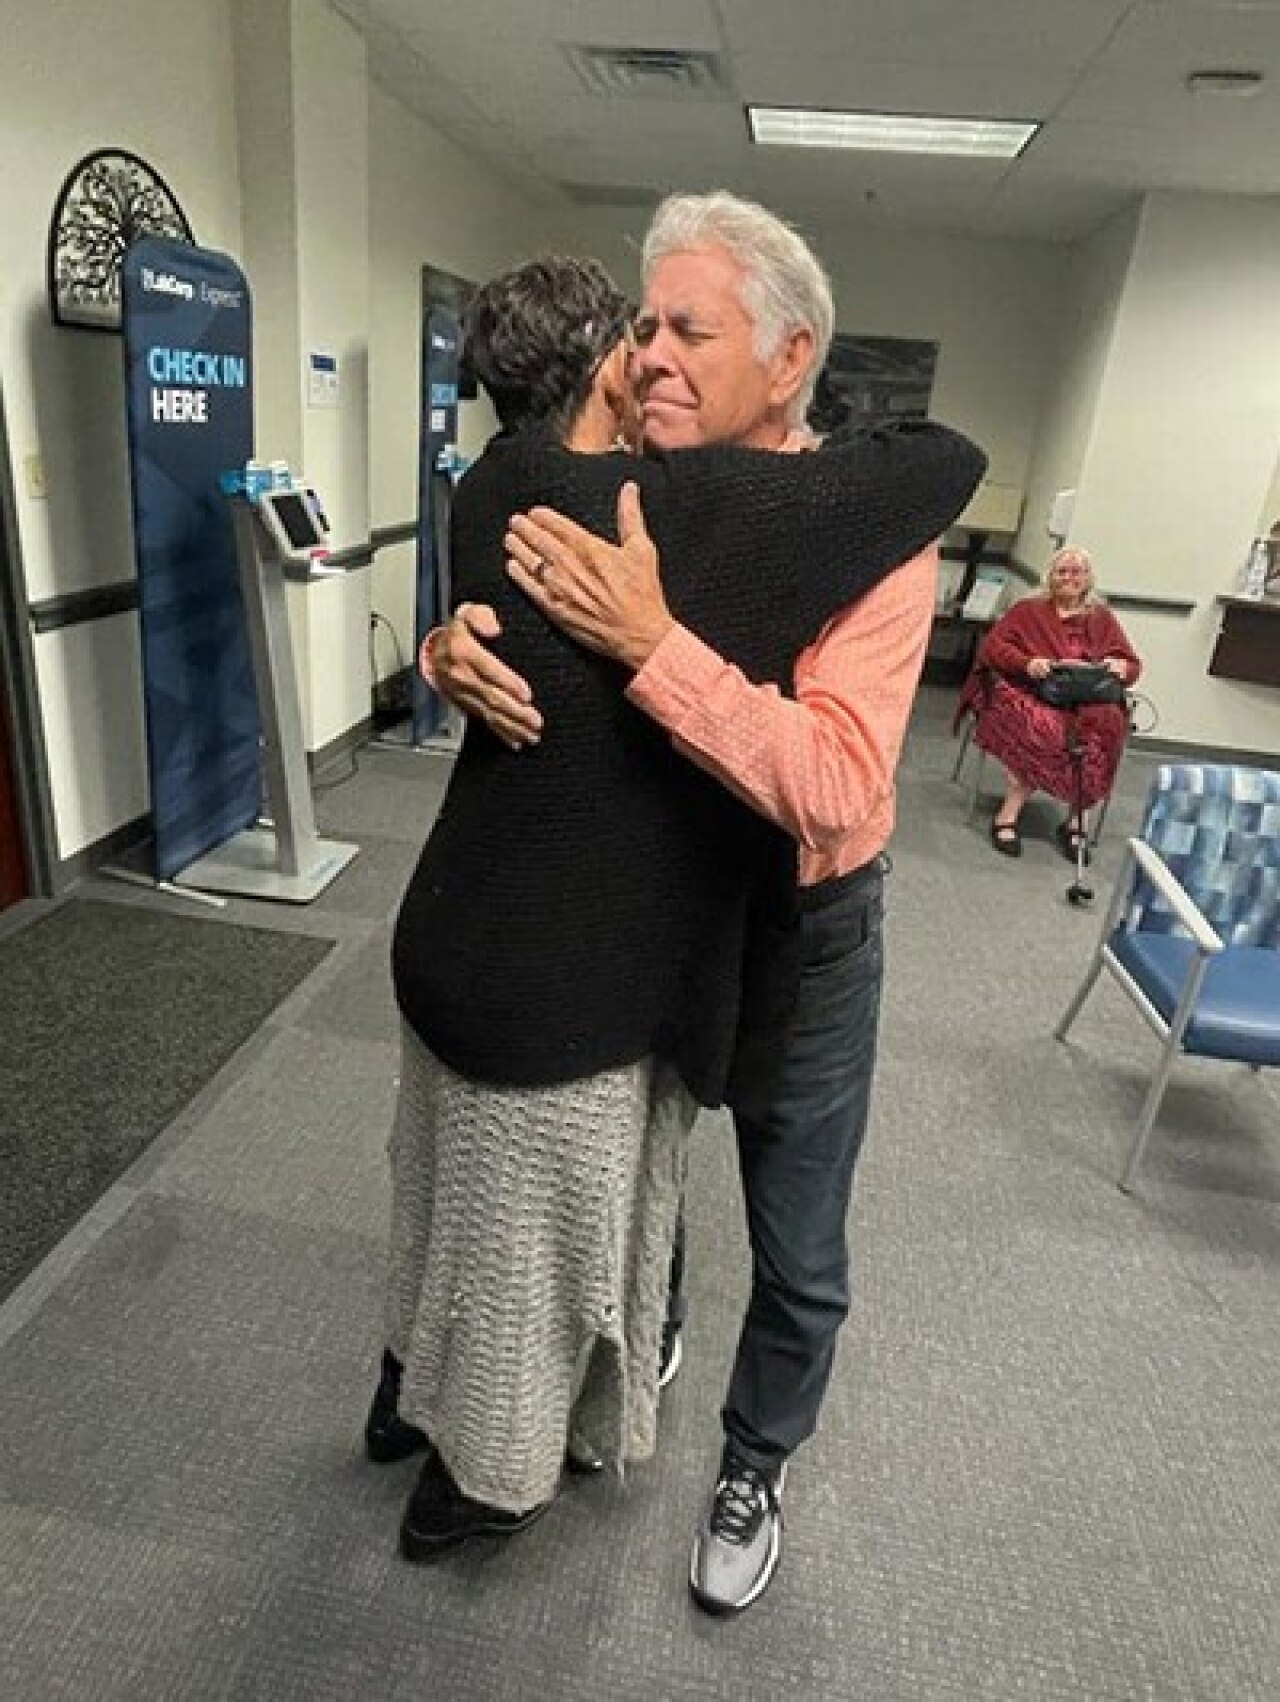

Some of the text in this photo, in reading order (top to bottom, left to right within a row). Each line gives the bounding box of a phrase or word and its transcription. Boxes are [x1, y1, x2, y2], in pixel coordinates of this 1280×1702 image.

[148, 346, 245, 388] CHECK IN
[152, 387, 208, 423] HERE
